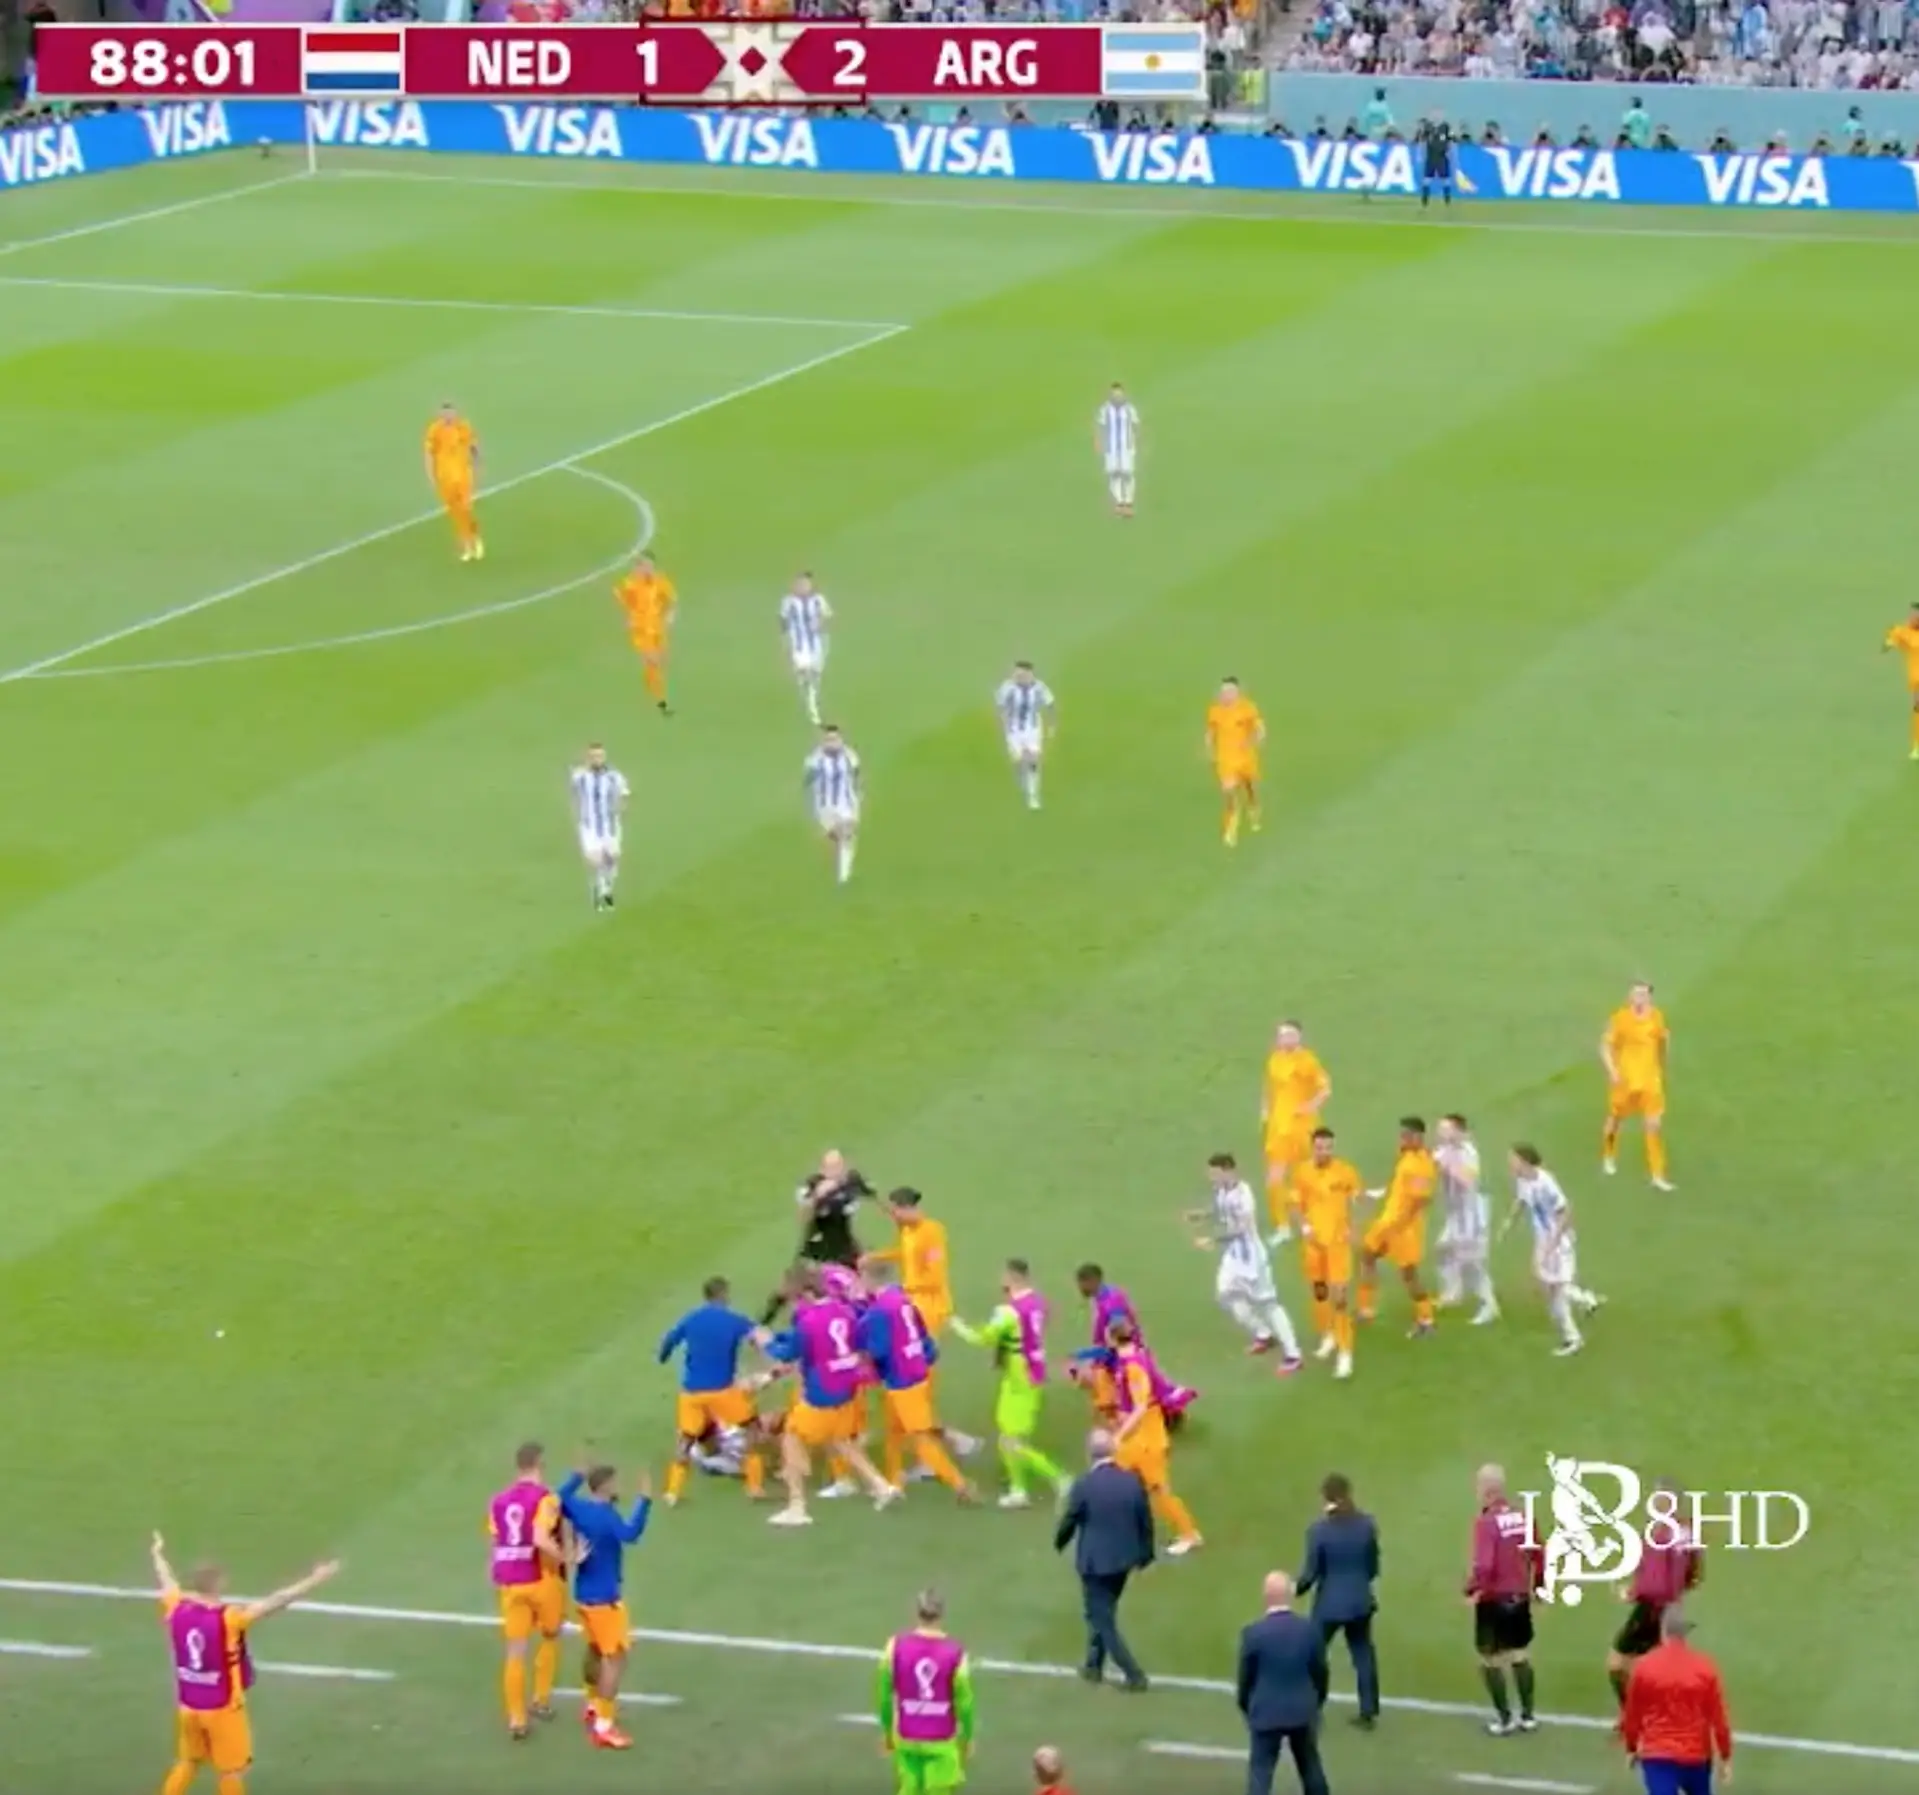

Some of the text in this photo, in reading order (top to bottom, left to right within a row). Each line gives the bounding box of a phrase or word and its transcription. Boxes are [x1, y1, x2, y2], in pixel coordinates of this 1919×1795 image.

[136, 98, 233, 158] VISA
[304, 97, 429, 147] VISA
[491, 103, 623, 157] VISA
[689, 112, 819, 168] VISA
[884, 122, 1016, 176] VISA
[0, 123, 86, 185] VISA
[1080, 130, 1215, 185] VISA
[1281, 138, 1416, 192] VISA
[1484, 145, 1621, 199] VISA
[1690, 154, 1830, 206] VISA
